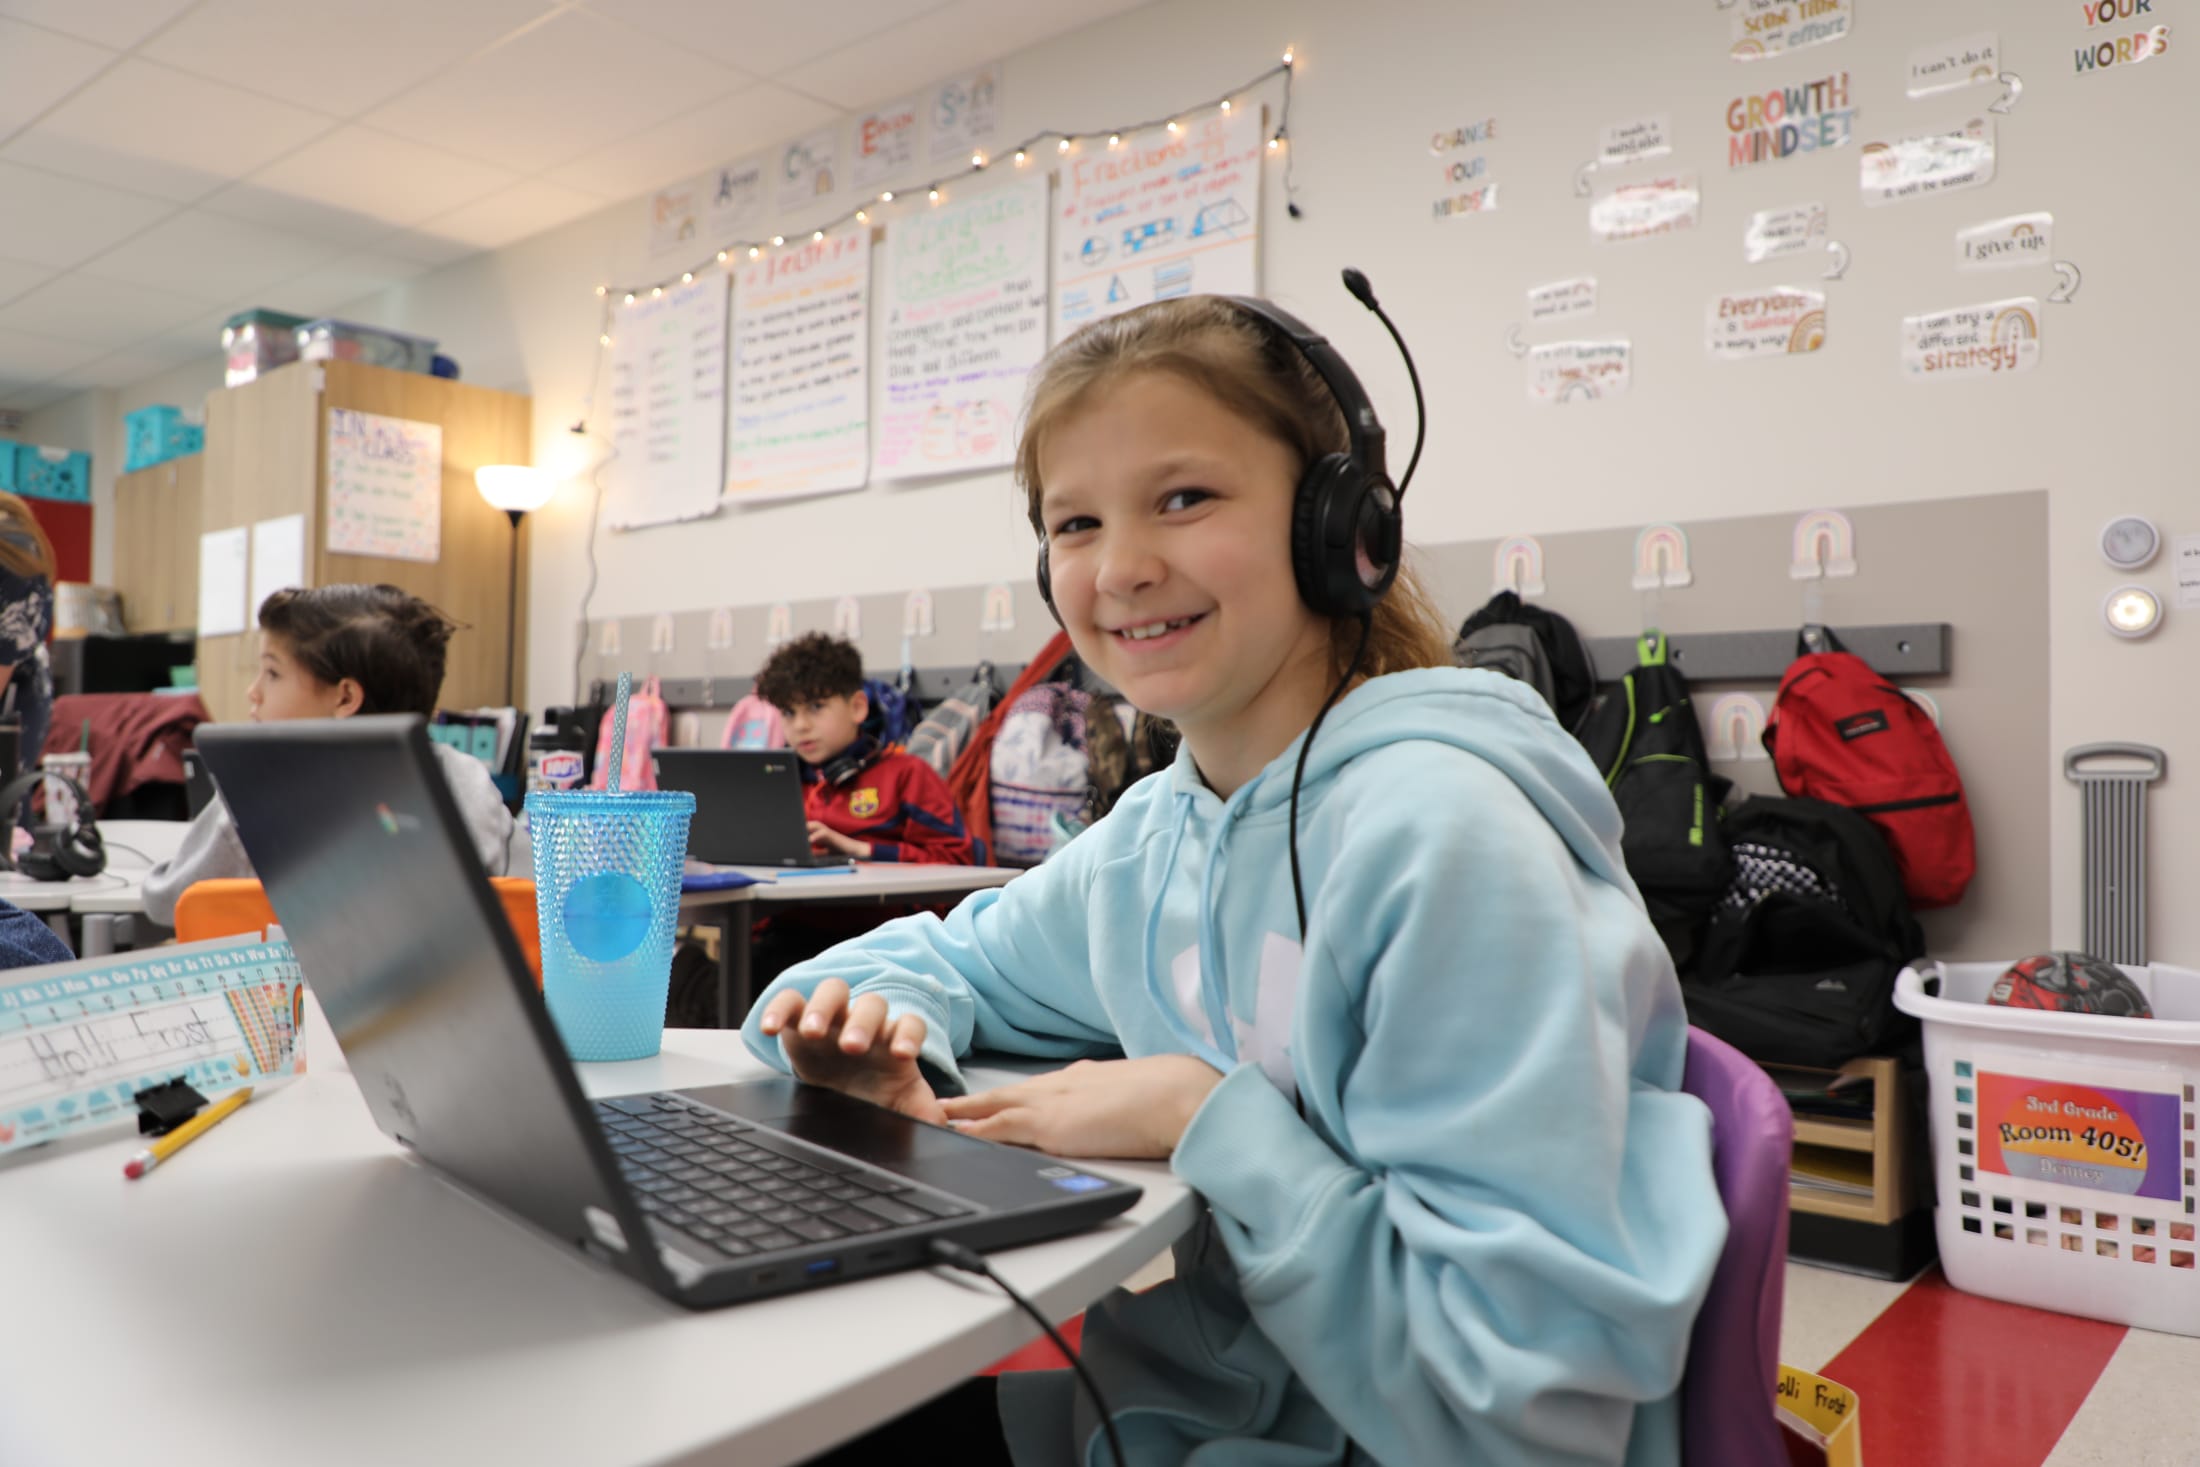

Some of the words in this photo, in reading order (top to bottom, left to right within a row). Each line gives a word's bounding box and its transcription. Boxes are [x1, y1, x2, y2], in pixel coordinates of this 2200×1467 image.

[2083, 0, 2152, 26] YOUR
[2074, 27, 2169, 72] WORDS
[1727, 72, 1849, 133] GROWTH
[1729, 110, 1856, 168] MINDSET
[1964, 241, 1971, 257] I
[1976, 240, 2014, 260] give
[2020, 235, 2046, 252] up
[1719, 294, 1807, 318] Everyone
[1924, 343, 2018, 373] strategy
[26, 1024, 119, 1082] Holli
[129, 1007, 208, 1048] Frost
[2026, 1096, 2059, 1115] 3rd
[2063, 1102, 2120, 1122] Grade
[2000, 1122, 2072, 1143] Room
[1776, 1375, 1801, 1400] olli
